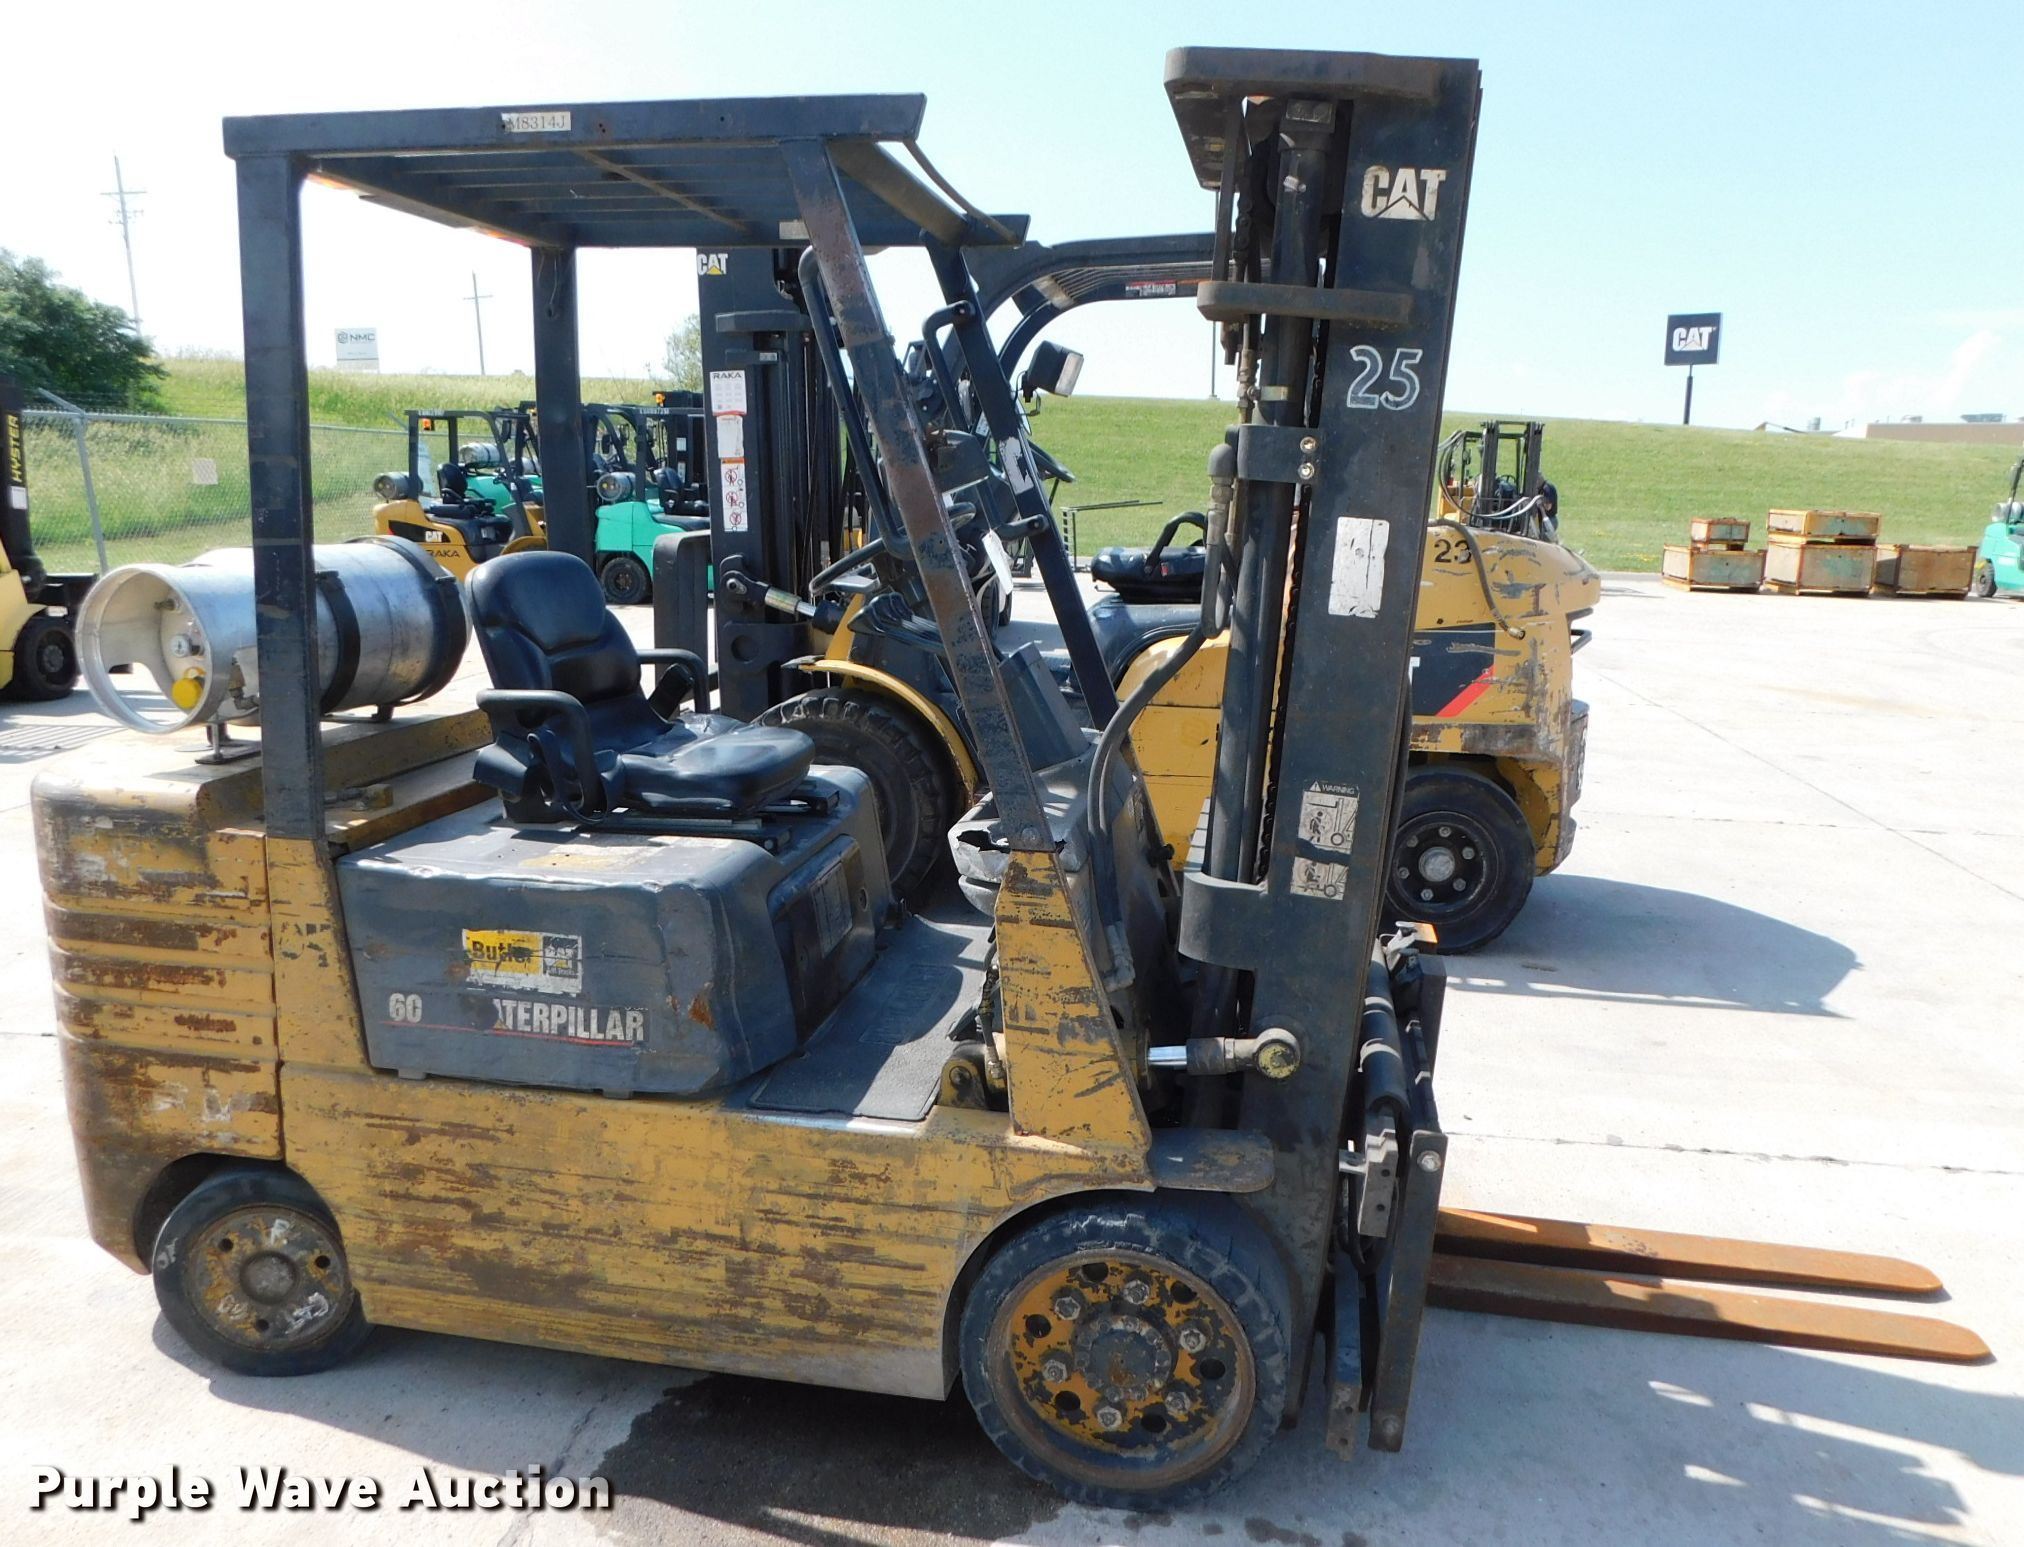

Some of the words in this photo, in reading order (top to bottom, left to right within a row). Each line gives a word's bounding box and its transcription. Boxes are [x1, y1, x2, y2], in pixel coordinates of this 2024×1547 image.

[1361, 165, 1447, 221] CAT
[697, 253, 728, 275] CAT
[350, 333, 376, 342] NMC
[1672, 326, 1713, 352] CAT
[712, 371, 743, 380] RAKA
[1346, 345, 1423, 411] 25
[7, 414, 22, 482] HYSTER
[425, 531, 443, 543] CAT
[1434, 539, 1472, 564] 23
[1321, 784, 1355, 795] WARNING
[388, 993, 422, 1023] 60
[492, 999, 644, 1041] TERPILLAR
